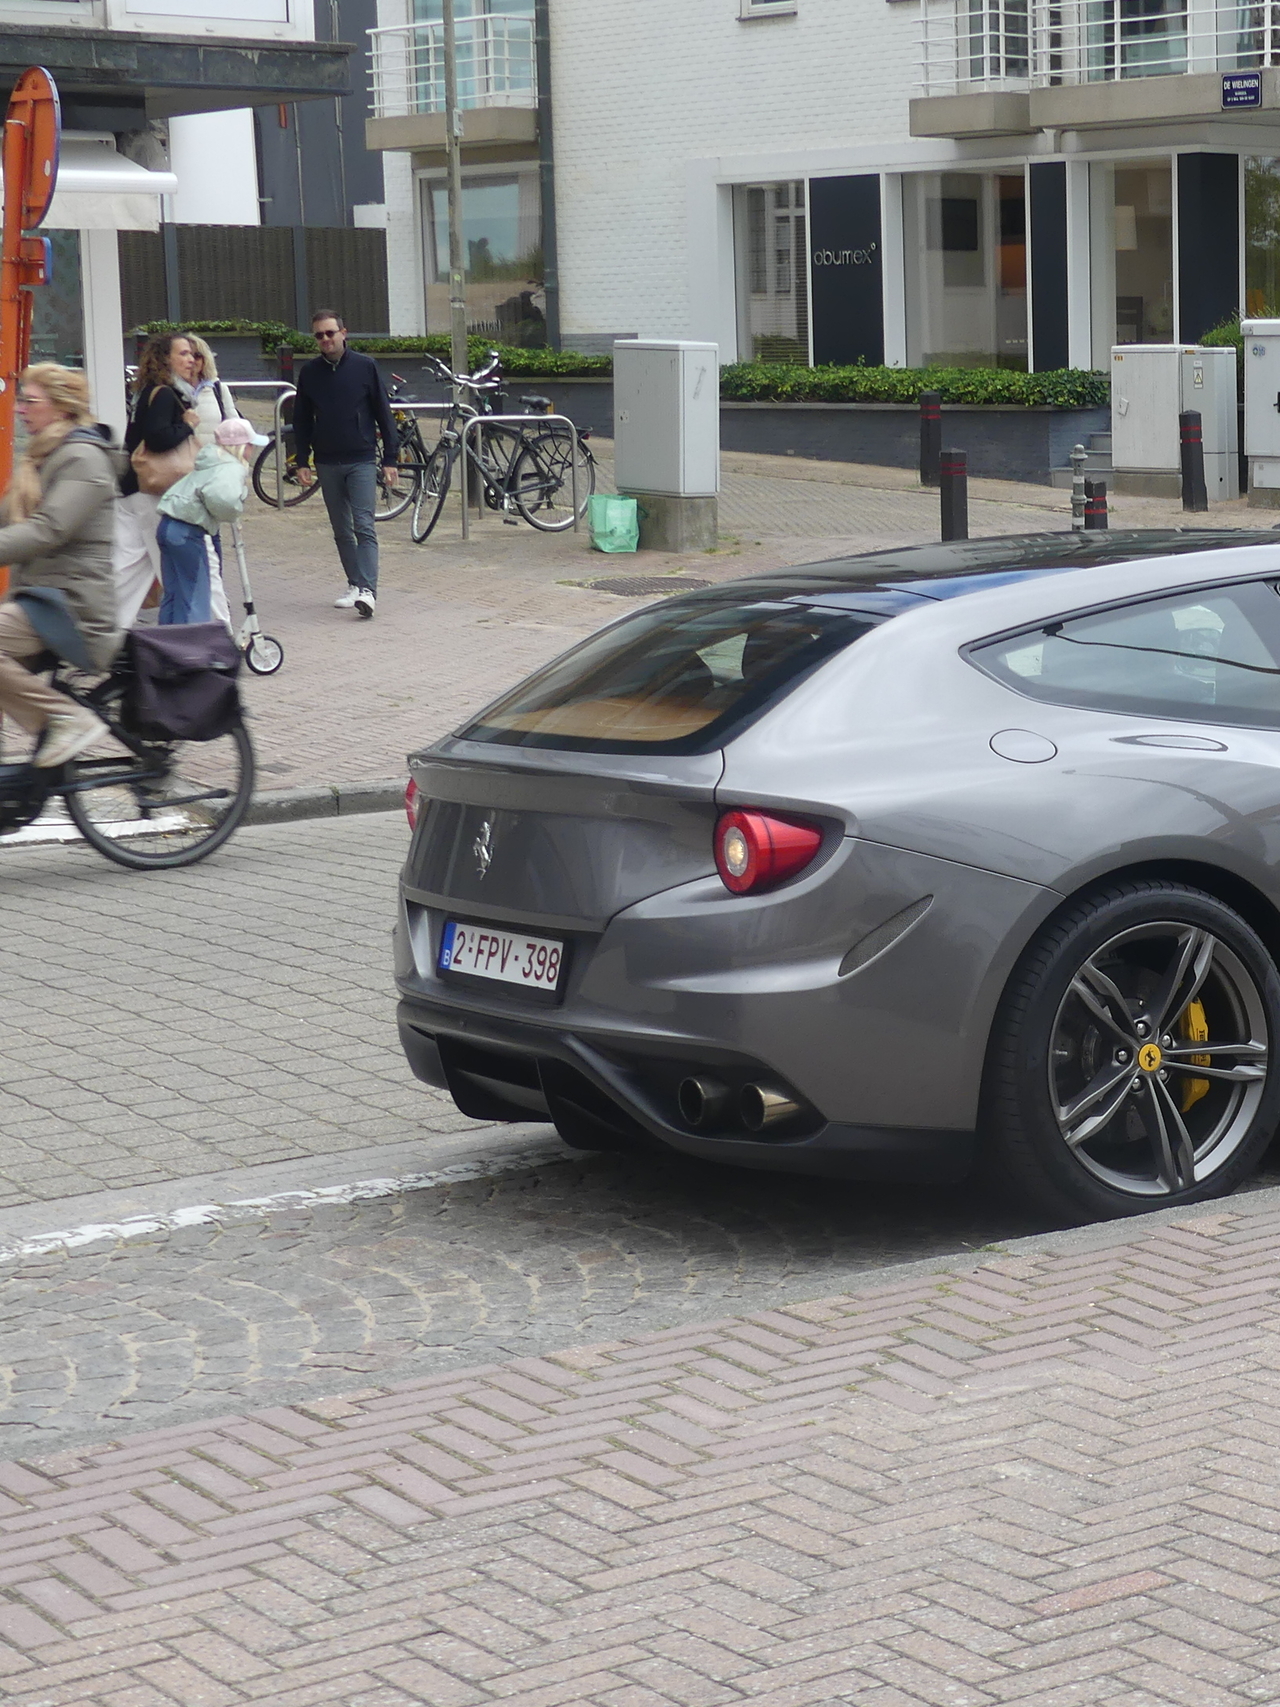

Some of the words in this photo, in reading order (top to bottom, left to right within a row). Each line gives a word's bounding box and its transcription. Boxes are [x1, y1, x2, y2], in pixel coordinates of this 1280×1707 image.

[1223, 81, 1231, 90] DE
[1232, 79, 1259, 89] WIELINGEN
[442, 949, 451, 966] B
